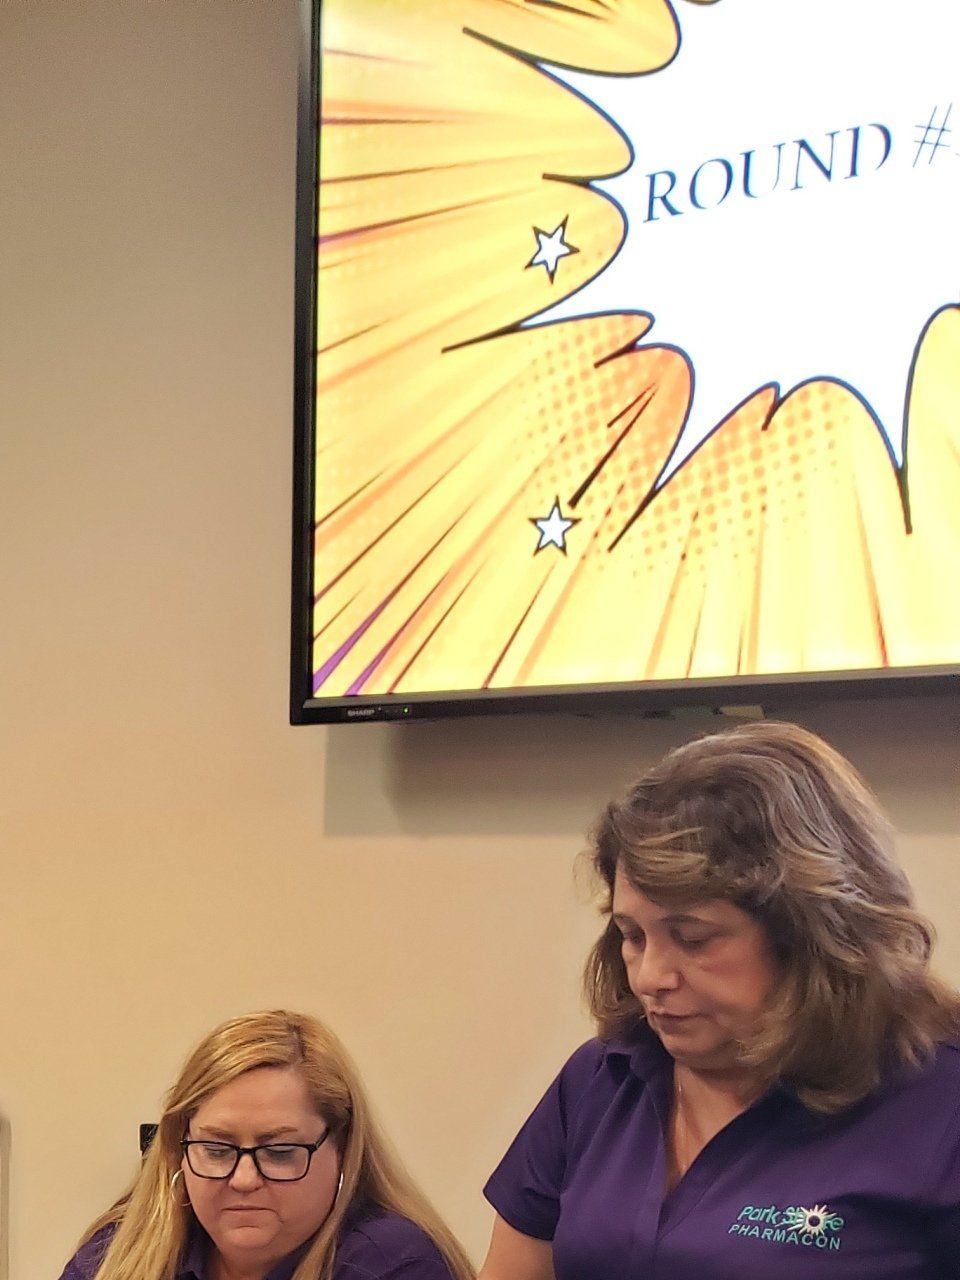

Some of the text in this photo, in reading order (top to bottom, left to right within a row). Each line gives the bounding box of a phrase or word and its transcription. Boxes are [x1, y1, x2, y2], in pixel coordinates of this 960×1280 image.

[643, 122, 892, 223] ROUND
[737, 1205, 780, 1225] Park
[728, 1223, 841, 1250] PHARMACON
